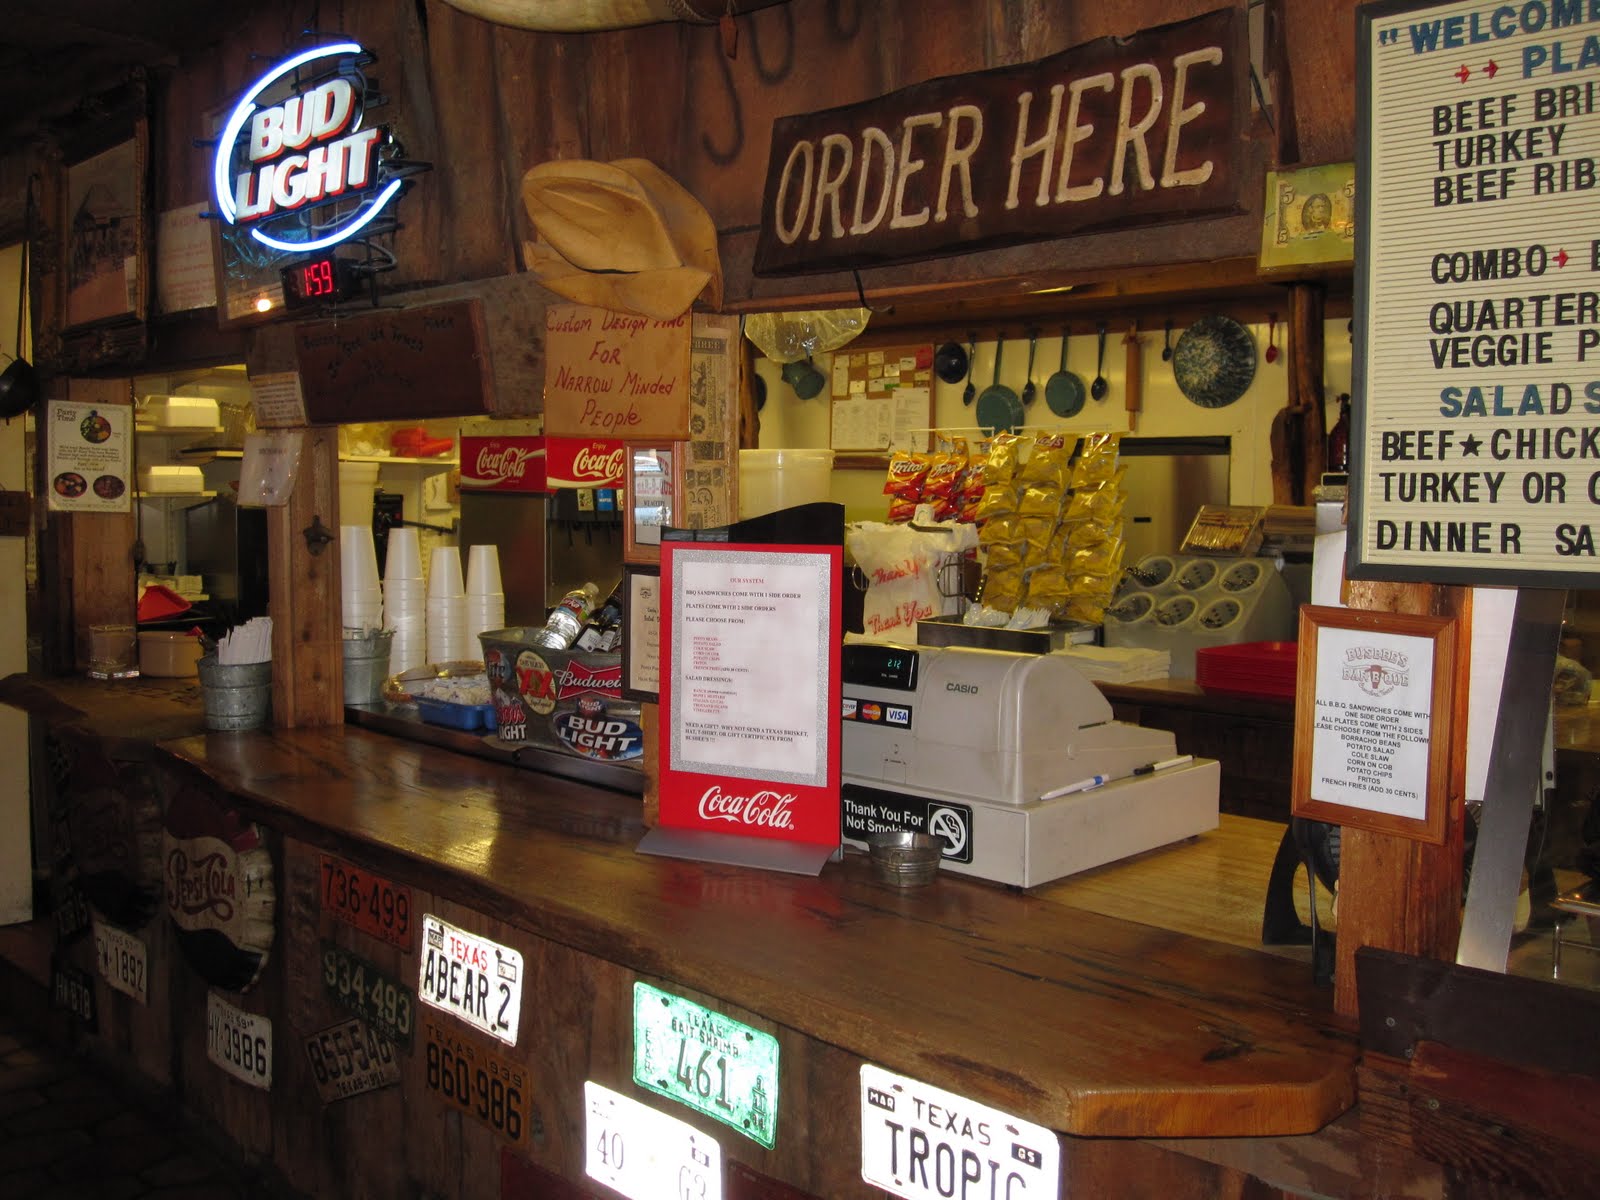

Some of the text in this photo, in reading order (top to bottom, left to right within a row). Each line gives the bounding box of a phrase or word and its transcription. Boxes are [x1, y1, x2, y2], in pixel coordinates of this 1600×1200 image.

[250, 79, 355, 163] BUD
[1432, 81, 1600, 137] BEEF BRI
[775, 46, 1222, 246] ORDER HERE
[1432, 123, 1566, 172] TURKEY
[236, 128, 382, 223] LIGHT
[1433, 158, 1596, 207] BEEF RIB
[304, 260, 334, 297] 1:59
[1431, 244, 1547, 284] COMBO
[1429, 291, 1600, 335] QUARTER
[1429, 331, 1553, 369] VEGGIE
[1381, 427, 1600, 461] BEEF CHICK
[572, 447, 624, 479] Coca-Co
[894, 461, 923, 474] Fritos
[1378, 471, 1506, 504] TURKEY
[1522, 472, 1567, 504] OR
[1376, 519, 1521, 555] DINNER
[554, 669, 621, 688] Budwei
[946, 682, 979, 695] CASIO
[567, 715, 628, 736] BUD
[889, 710, 907, 722] VISA
[1334, 717, 1358, 726] PLATES
[1360, 721, 1378, 729] COME
[1403, 727, 1423, 735] SIDES
[1349, 703, 1391, 715] SANDWICHES
[1394, 708, 1412, 718] COME
[1414, 711, 1430, 720] WITH
[1376, 714, 1399, 723] ORDER
[560, 726, 638, 752] LIGHT
[1334, 725, 1360, 734] CHOOSE
[1362, 729, 1381, 737] FROM
[1341, 734, 1401, 748] BORRACHO BEANS
[1347, 743, 1395, 755] POTATO SALAD
[1347, 758, 1365, 766] CORN
[1370, 754, 1389, 762] SLAW
[1321, 777, 1347, 787] FRENCH
[1348, 781, 1366, 790] FRIES
[1368, 784, 1384, 793] (ADD
[1347, 766, 1393, 778] POTATO CHIPS
[1358, 775, 1380, 785] FRITOS
[698, 785, 798, 829] Coca-Cola
[845, 799, 924, 827] Thank You For
[846, 816, 912, 833] Not Smoki
[450, 936, 488, 971] TEXAS
[424, 948, 511, 1031] ABEAR 2
[672, 1016, 739, 1057] BAIT SHRIMP
[688, 1012, 724, 1038] TEXAS
[676, 1038, 736, 1113] 461
[869, 1090, 894, 1109] MAR
[913, 1096, 991, 1146] TEXAS
[597, 1128, 624, 1170] 40
